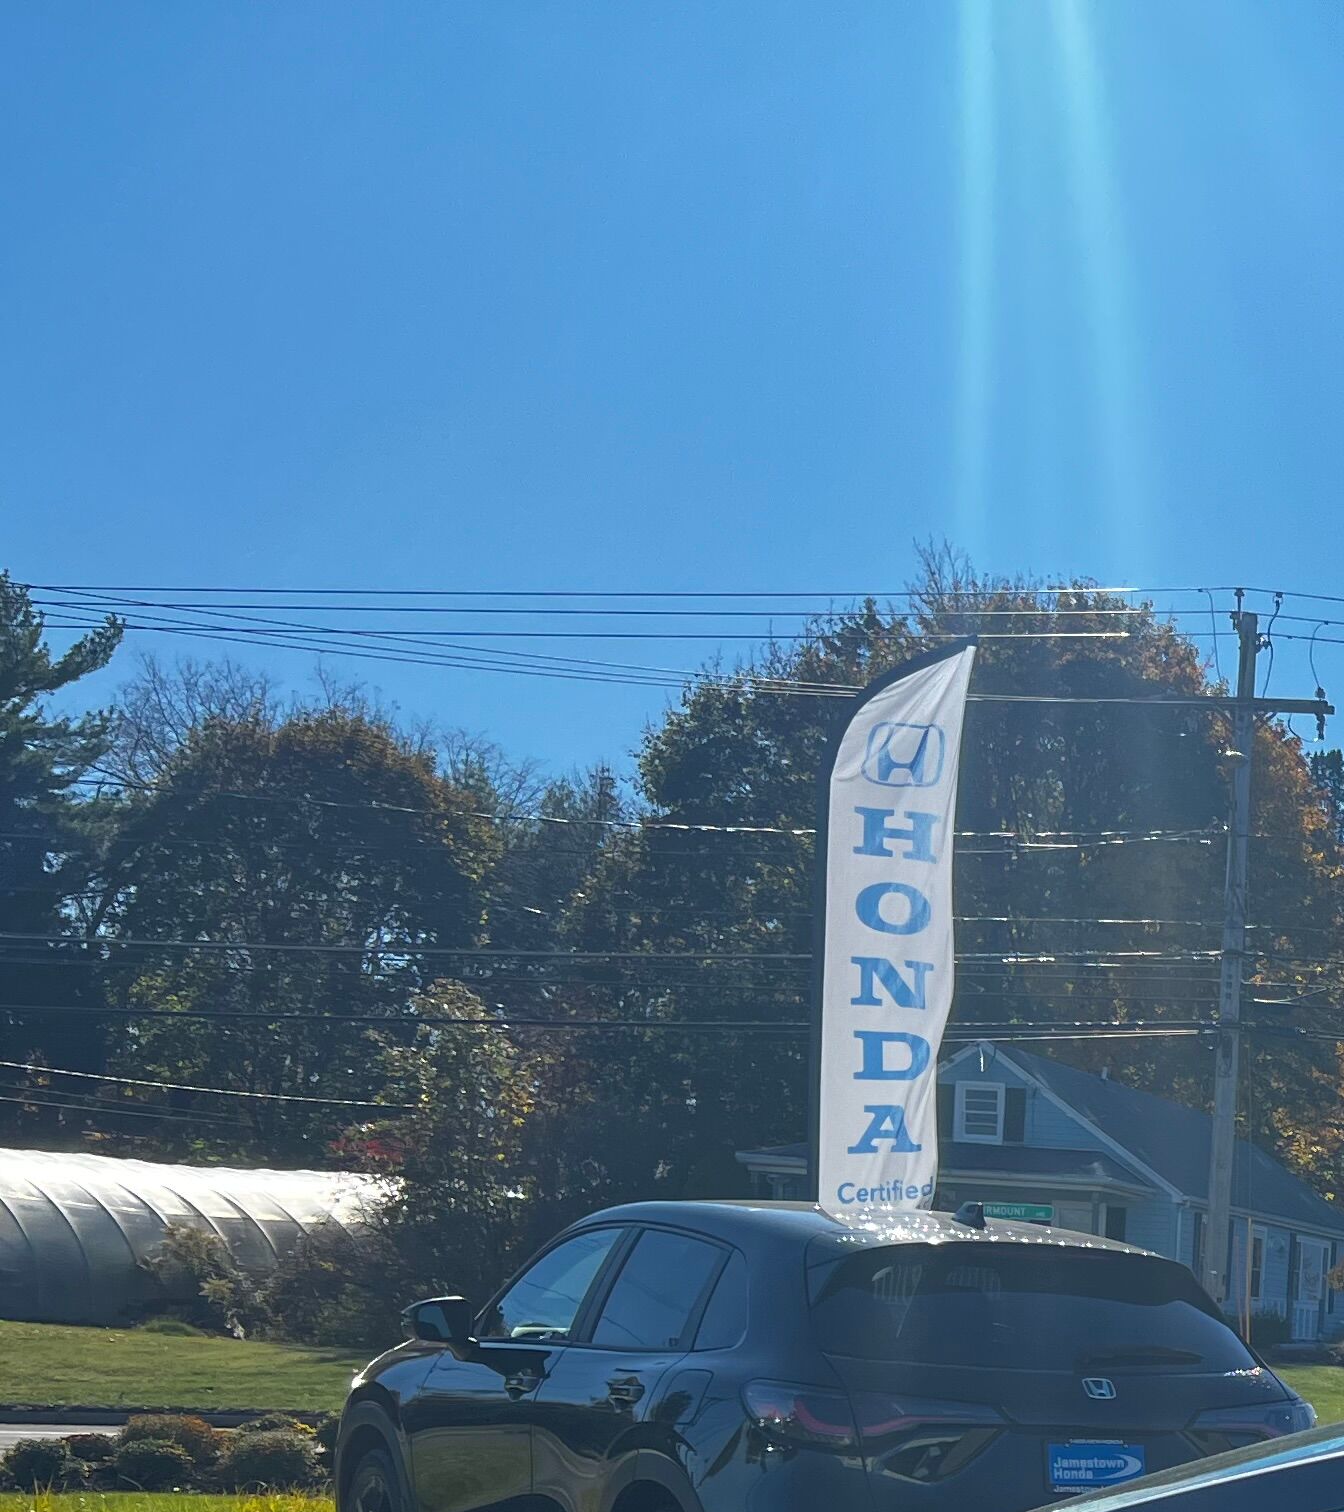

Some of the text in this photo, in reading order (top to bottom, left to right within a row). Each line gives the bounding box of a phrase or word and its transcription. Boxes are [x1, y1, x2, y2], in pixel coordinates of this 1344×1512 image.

[847, 806, 939, 1154] HONDA
[838, 1176, 933, 1204] Certified
[983, 1206, 1026, 1217] IRMOUNT
[1054, 1457, 1124, 1468] Jamestown
[1053, 1468, 1094, 1480] Honda
